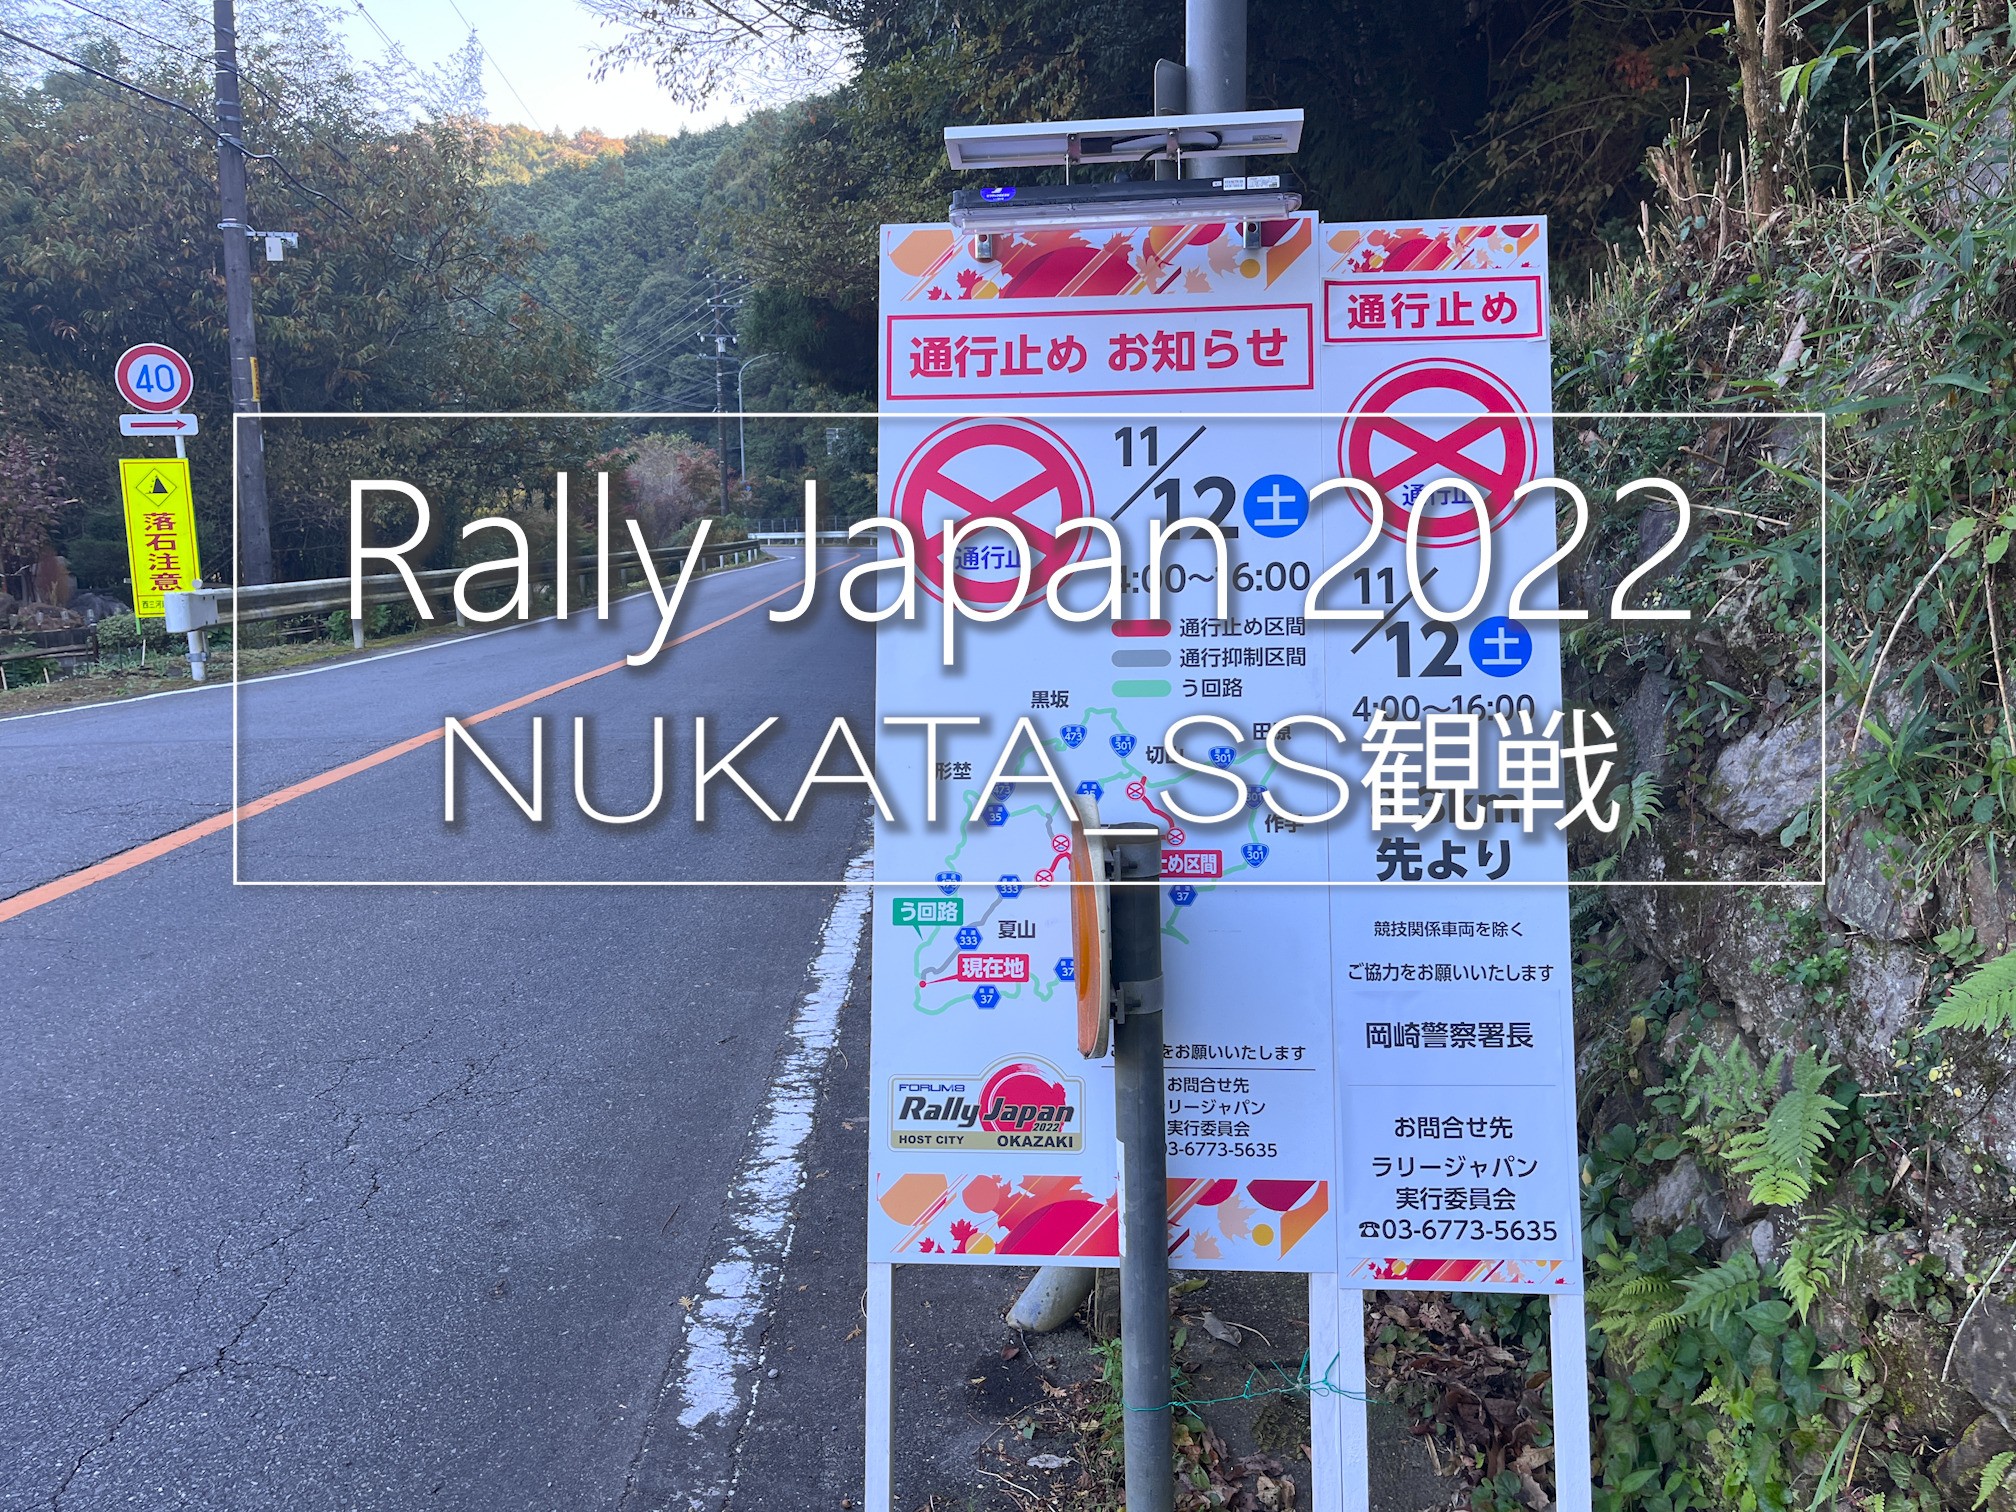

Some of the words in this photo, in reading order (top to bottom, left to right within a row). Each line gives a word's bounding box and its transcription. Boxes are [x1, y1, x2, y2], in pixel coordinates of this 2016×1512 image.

[1347, 291, 1518, 330] 通行止め
[909, 334, 1088, 378] 通行止め
[1108, 327, 1288, 373] お知らせ
[136, 364, 175, 393] 40
[1254, 483, 1299, 527] 土
[143, 512, 182, 592] 落石注意
[142, 600, 165, 609] 西三河
[1179, 617, 1306, 638] 通行止め区間
[1481, 626, 1522, 666] 土
[1179, 647, 1307, 668] 通行抑制区間
[1182, 678, 1244, 698] う回路
[1030, 690, 1070, 709] 黒坂
[1064, 732, 1083, 741] 473
[1114, 741, 1132, 751] 301
[1214, 753, 1231, 763] 301
[989, 812, 1002, 822] 35
[1246, 850, 1264, 860] 301
[1376, 837, 1511, 882] 先より
[1176, 892, 1189, 901] 37
[900, 901, 959, 922] う回路
[997, 919, 1036, 939] 夏山
[1373, 920, 1524, 938] 競技関係車両を除く
[959, 936, 978, 946] 333
[961, 957, 1025, 979] 現在地
[1061, 967, 1074, 977] 37
[1347, 962, 1554, 982] ご協力をお願いいたします
[980, 994, 993, 1004] 37
[1365, 1021, 1534, 1050] 岡崎警察署長
[899, 1084, 966, 1092] FORUM8
[1167, 1077, 1250, 1094] お問合せ先
[898, 1096, 981, 1128] Rally
[983, 1097, 1075, 1129] Japan
[1032, 1122, 1060, 1132] 2022
[1167, 1120, 1250, 1138] 実行委員会
[1394, 1115, 1513, 1139] お問合せ先
[899, 1135, 932, 1144] HOST
[936, 1135, 965, 1145] CITY
[997, 1135, 1074, 1148] OKAZAKI
[1164, 1141, 1278, 1159] 3-6773-5635
[1371, 1154, 1538, 1179] ラリージャパン
[1395, 1186, 1517, 1212] 実行委員会
